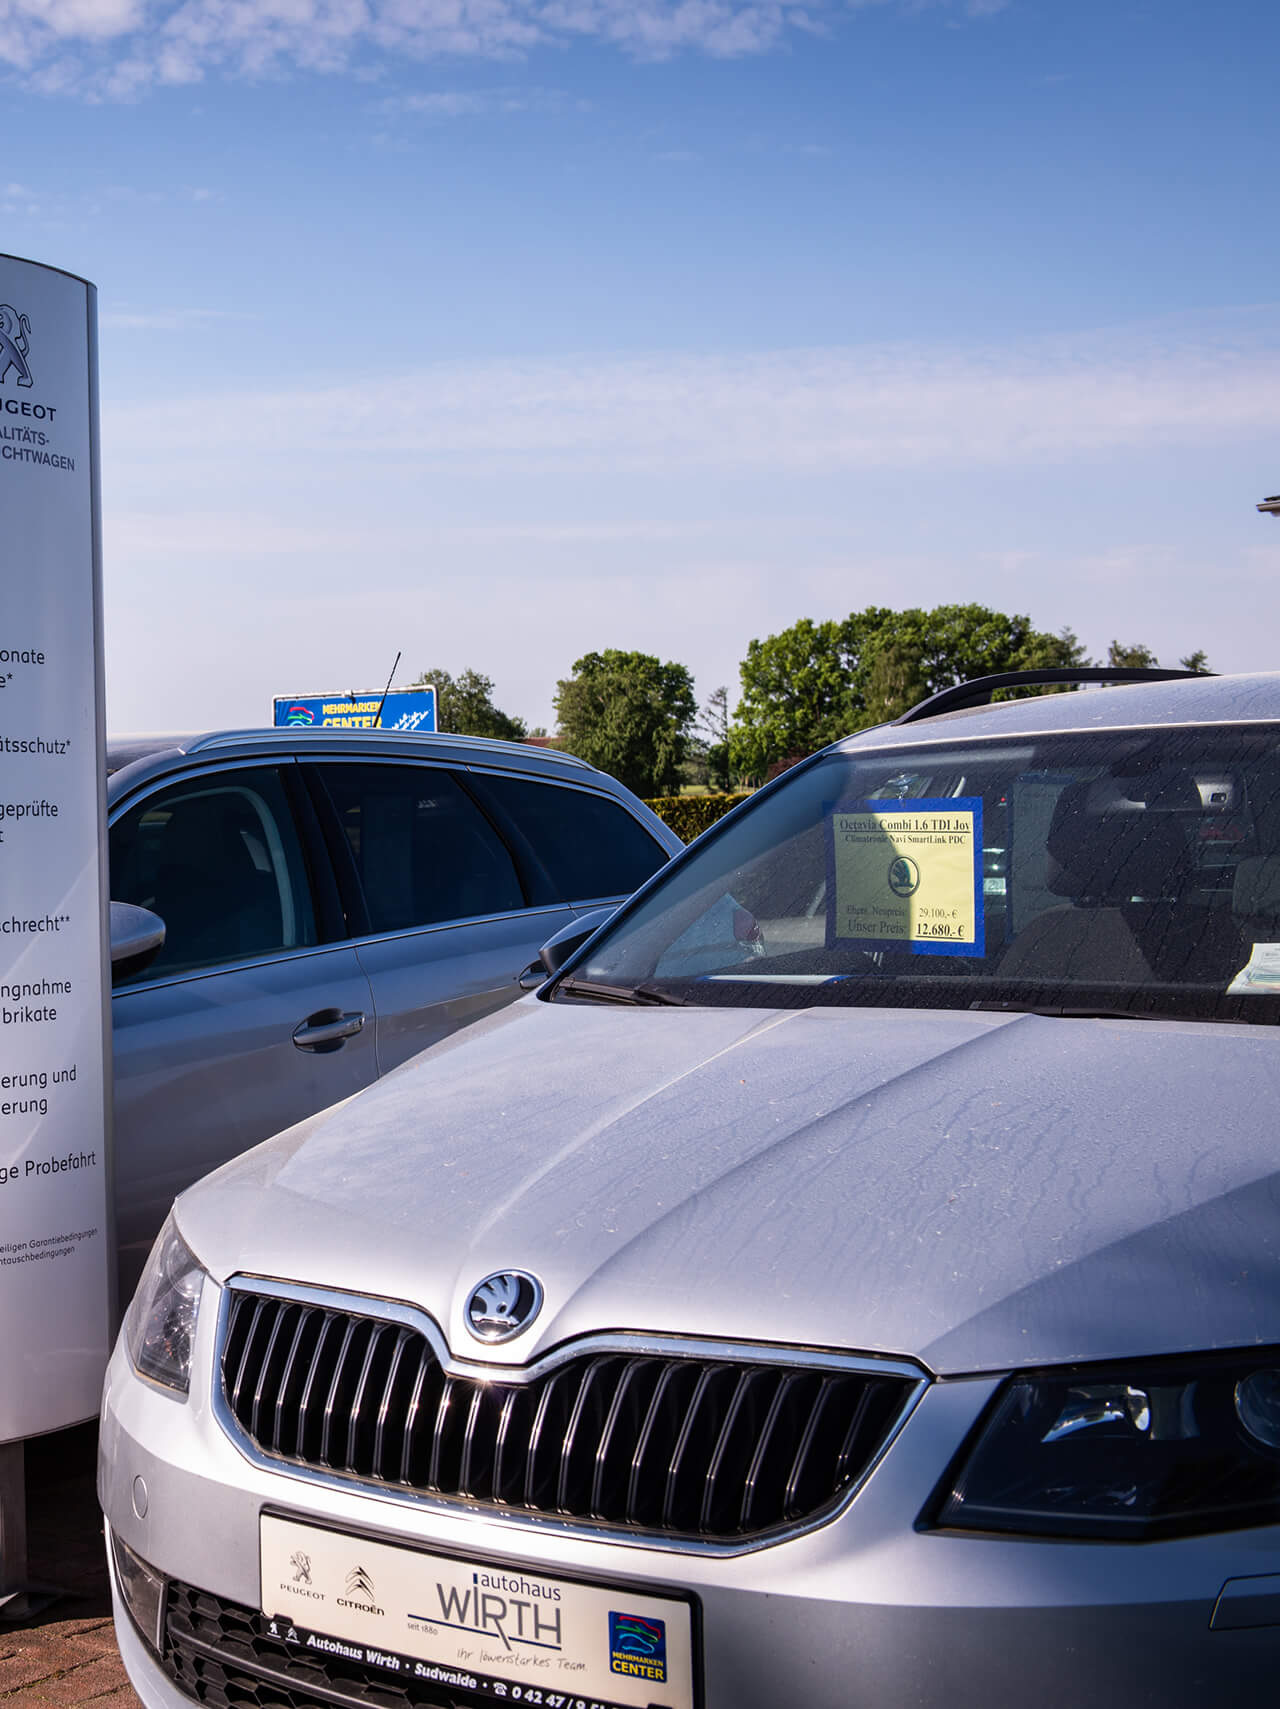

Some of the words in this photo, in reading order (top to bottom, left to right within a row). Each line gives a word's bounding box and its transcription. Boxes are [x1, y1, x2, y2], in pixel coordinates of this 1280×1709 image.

[840, 819, 878, 830] Octavia
[880, 819, 912, 830] Combi
[915, 819, 929, 830] 1.6
[931, 819, 951, 830] TDI
[890, 835, 906, 844] Navi
[907, 835, 947, 844] SmartLink
[948, 835, 967, 845] PDC
[848, 920, 877, 933] Unser
[958, 925, 964, 937] €
[52, 1064, 77, 1084] und
[24, 1152, 96, 1177] Probefahrt
[29, 1227, 98, 1249] Garantiebedingungen
[280, 1583, 326, 1601] PEUGEOT
[481, 1573, 561, 1600] autohaus
[336, 1598, 385, 1616] CITROËN
[407, 1622, 420, 1632] seit
[306, 1634, 363, 1660] Autohaus
[366, 1650, 401, 1671] Wirth
[415, 1663, 477, 1689] Sudwalde
[512, 1686, 522, 1700] 0
[524, 1688, 543, 1705] 42
[545, 1694, 566, 1708] 47
[612, 1660, 665, 1680] CENTER
